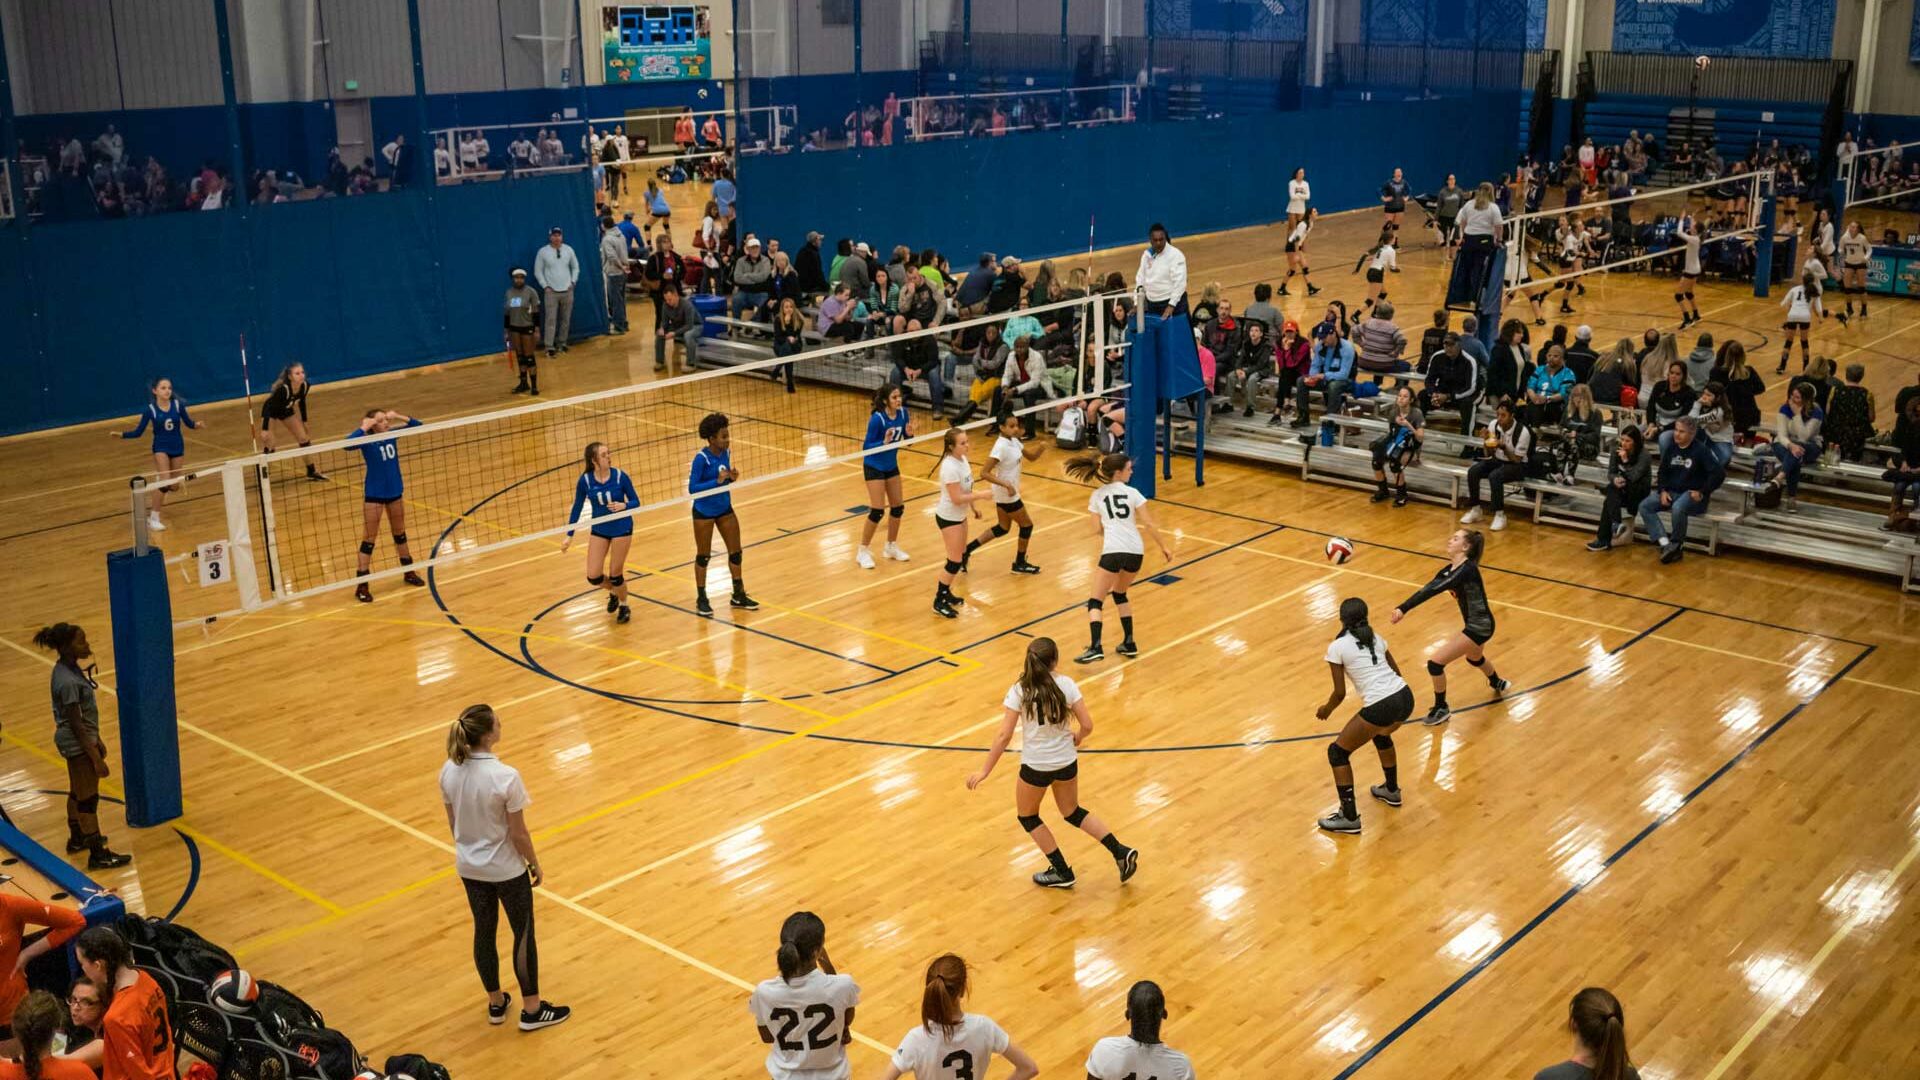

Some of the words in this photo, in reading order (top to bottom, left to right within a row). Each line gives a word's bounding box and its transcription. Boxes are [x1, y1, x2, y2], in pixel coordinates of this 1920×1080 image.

[164, 418, 174, 431] 6
[380, 443, 396, 461] 10
[597, 490, 612, 506] 11
[1103, 494, 1130, 519] 15
[209, 561, 221, 580] 3
[153, 1006, 169, 1056] 3
[770, 1003, 838, 1051] 22
[942, 1049, 974, 1080] 3
